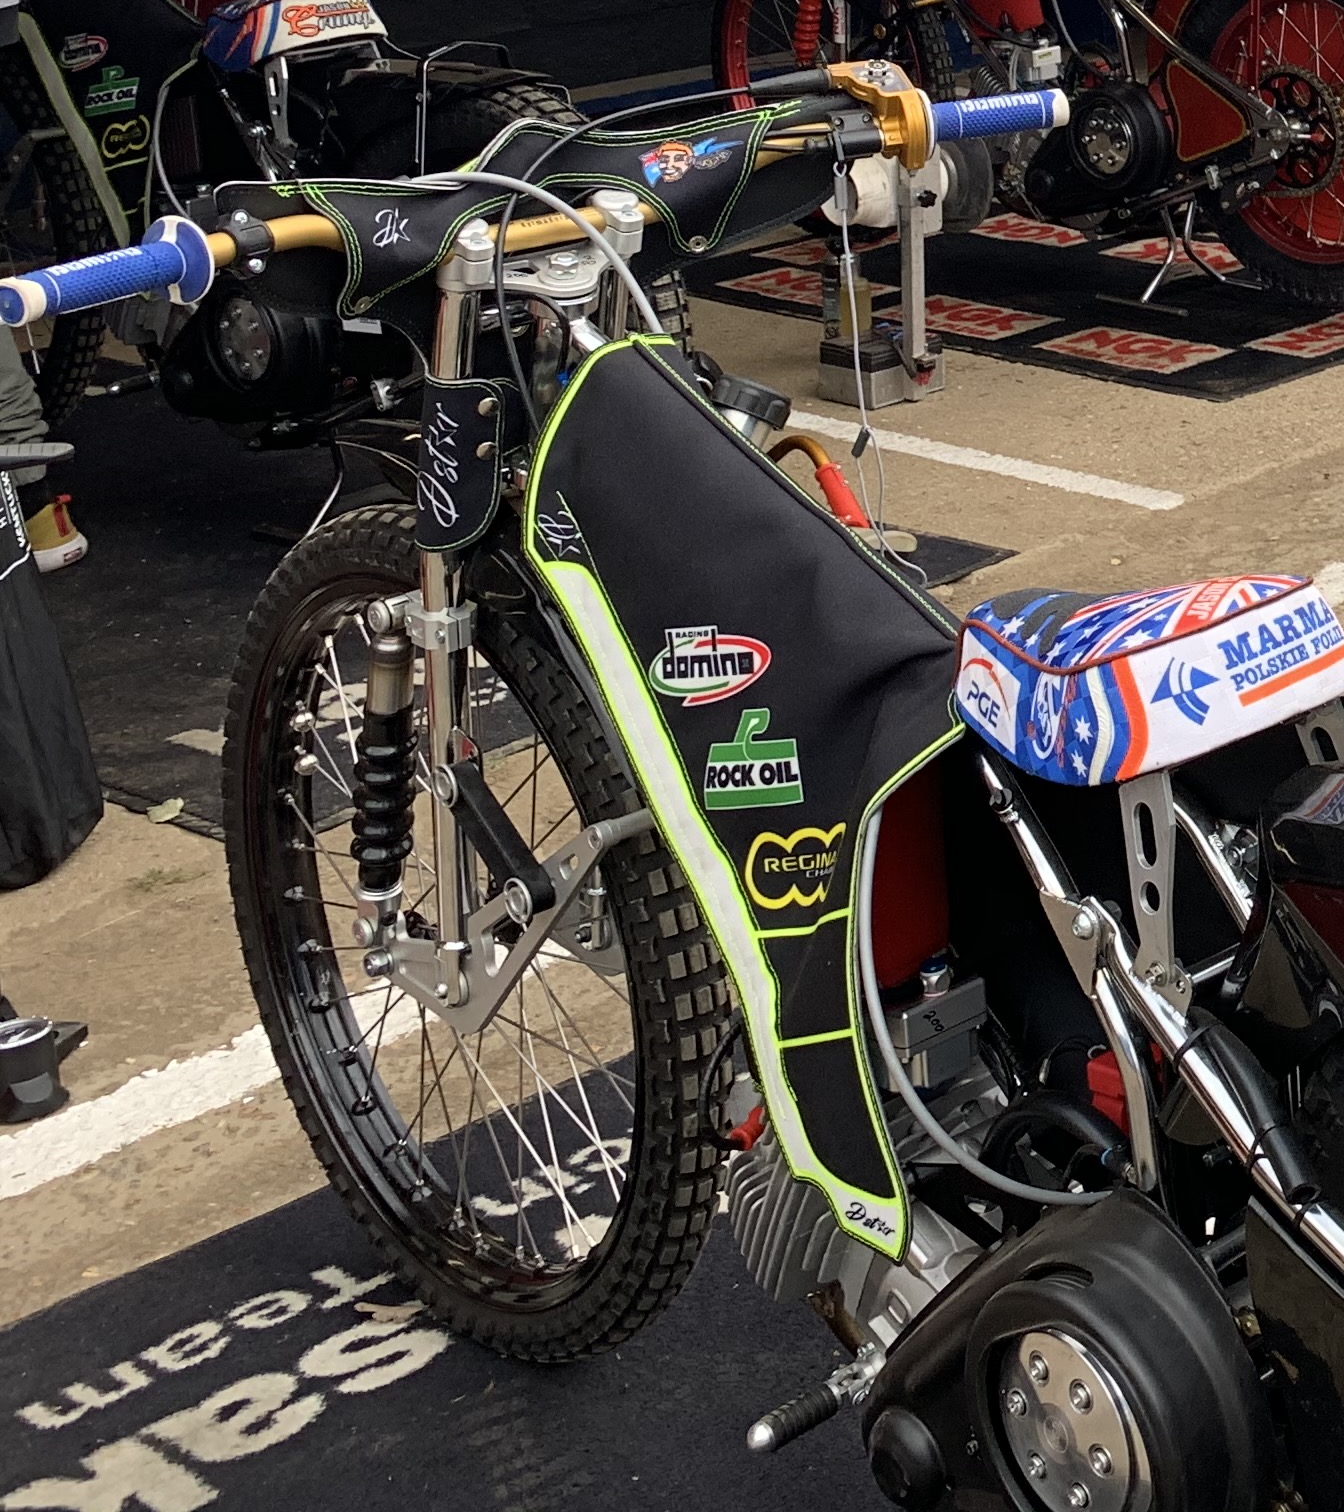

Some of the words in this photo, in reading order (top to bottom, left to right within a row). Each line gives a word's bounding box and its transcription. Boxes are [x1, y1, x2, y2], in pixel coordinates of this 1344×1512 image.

[1066, 328, 1219, 365] NGK
[675, 629, 709, 639] RACING
[1230, 642, 1311, 693] POLSKIE
[966, 680, 1001, 729] PGE
[705, 763, 756, 789] ROCK
[759, 760, 799, 785] OIL
[764, 852, 837, 874] REGINA
[923, 1010, 945, 1032] 200
